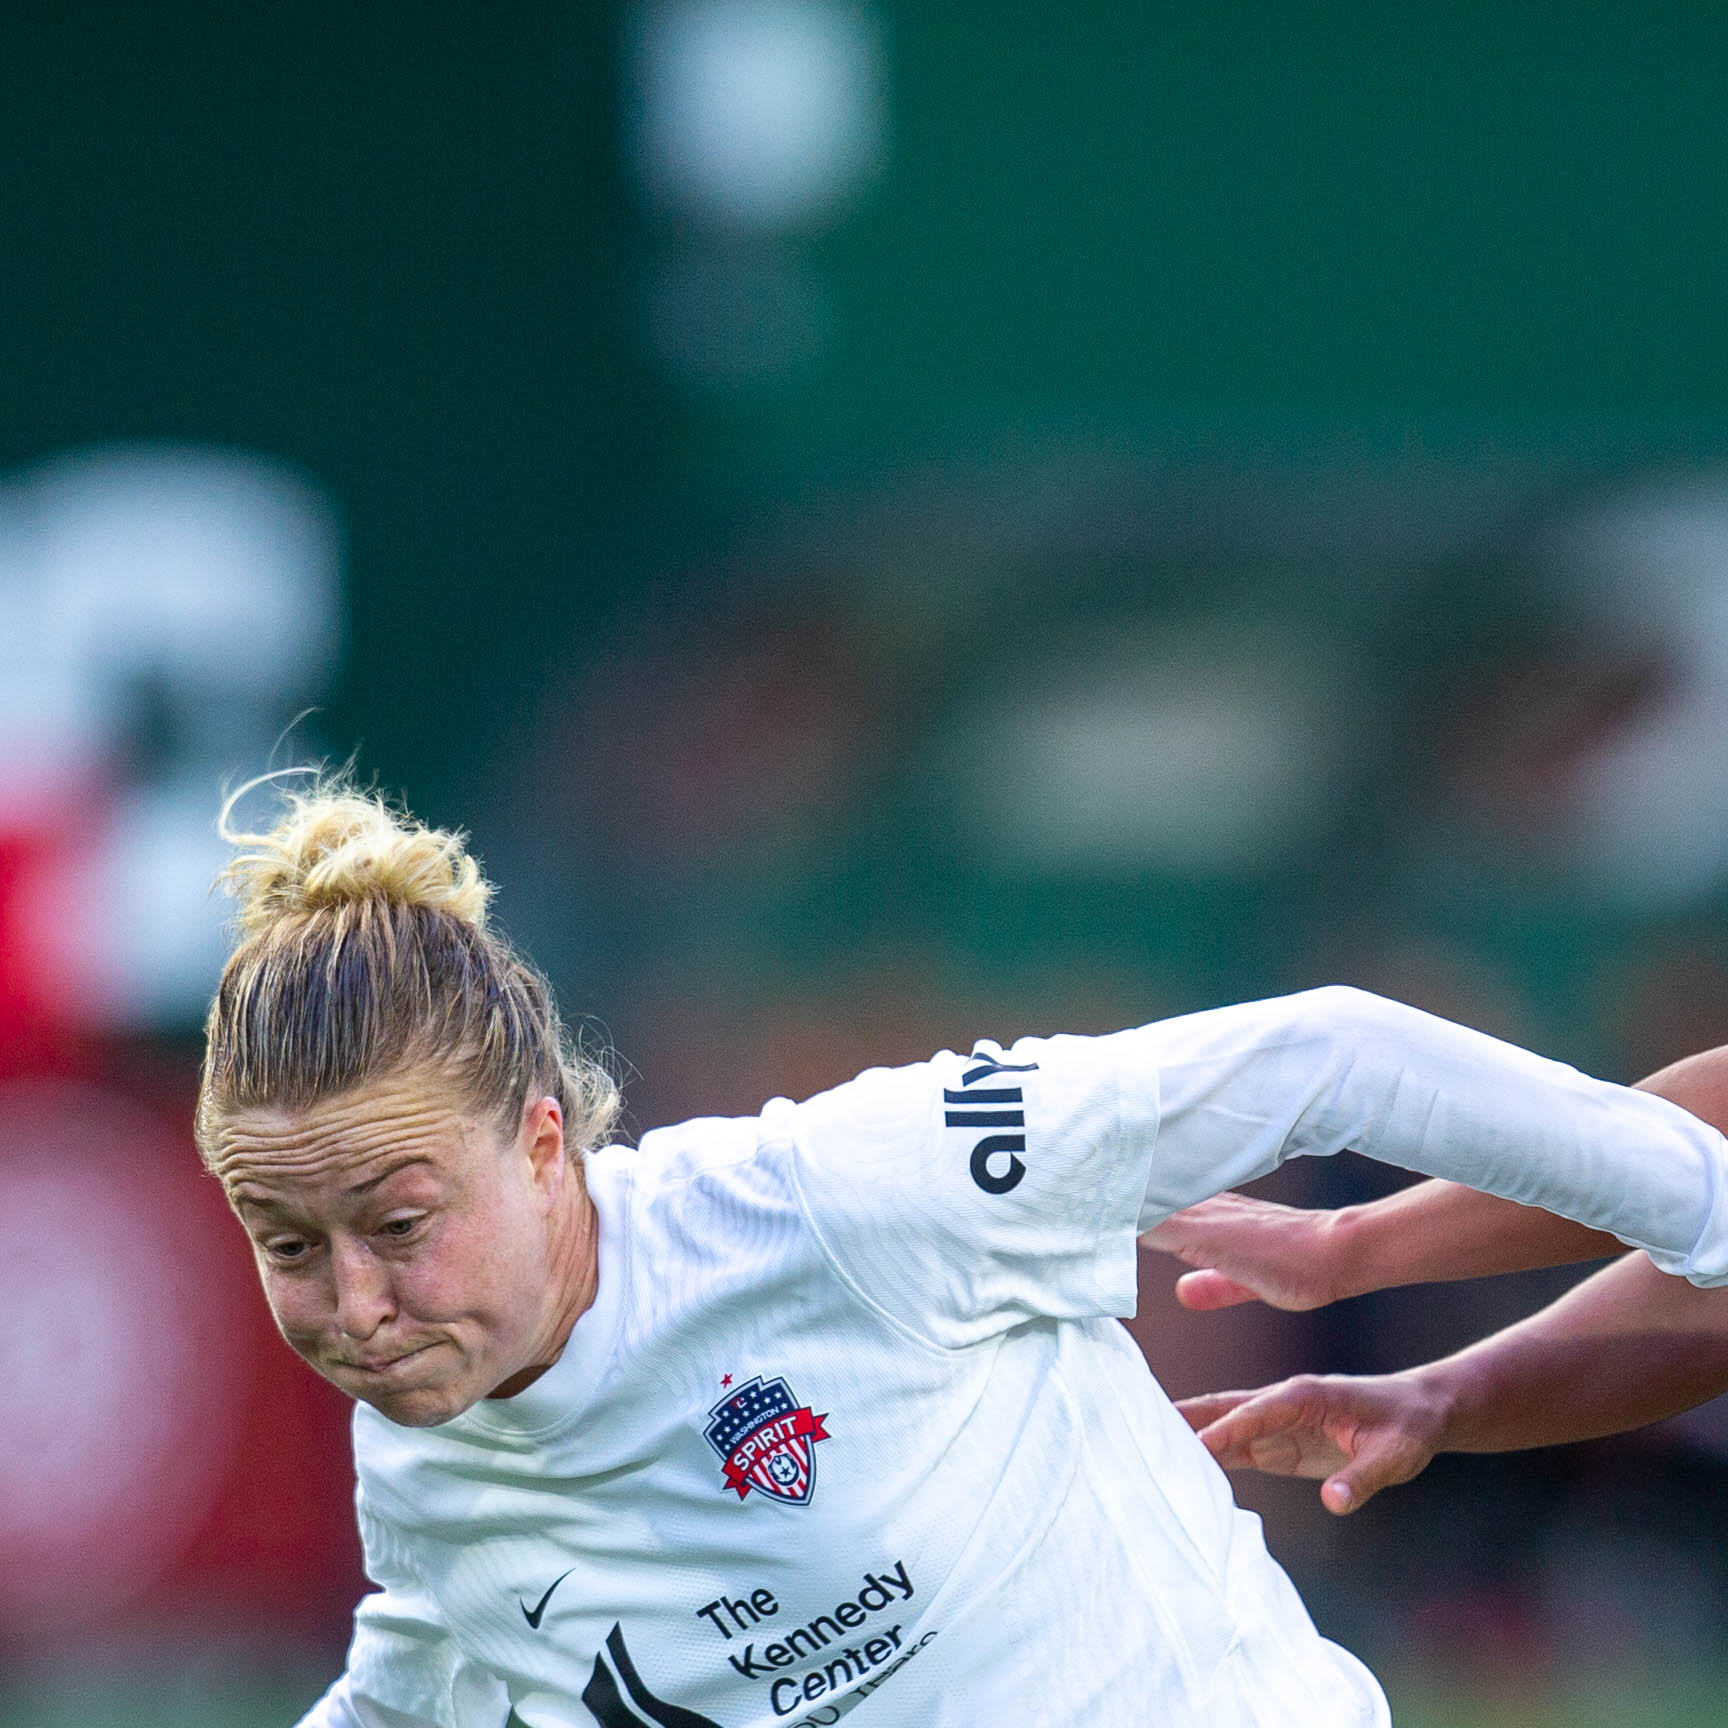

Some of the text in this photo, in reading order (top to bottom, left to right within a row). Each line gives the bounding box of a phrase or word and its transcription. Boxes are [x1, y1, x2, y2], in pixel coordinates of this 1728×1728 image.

[943, 1052, 1040, 1196] ally
[729, 1406, 780, 1445] WASHINGTON
[733, 1416, 797, 1471] SPIRIT
[696, 1588, 779, 1640] The
[728, 1560, 915, 1680] Kennedy
[770, 1624, 903, 1717] Center
